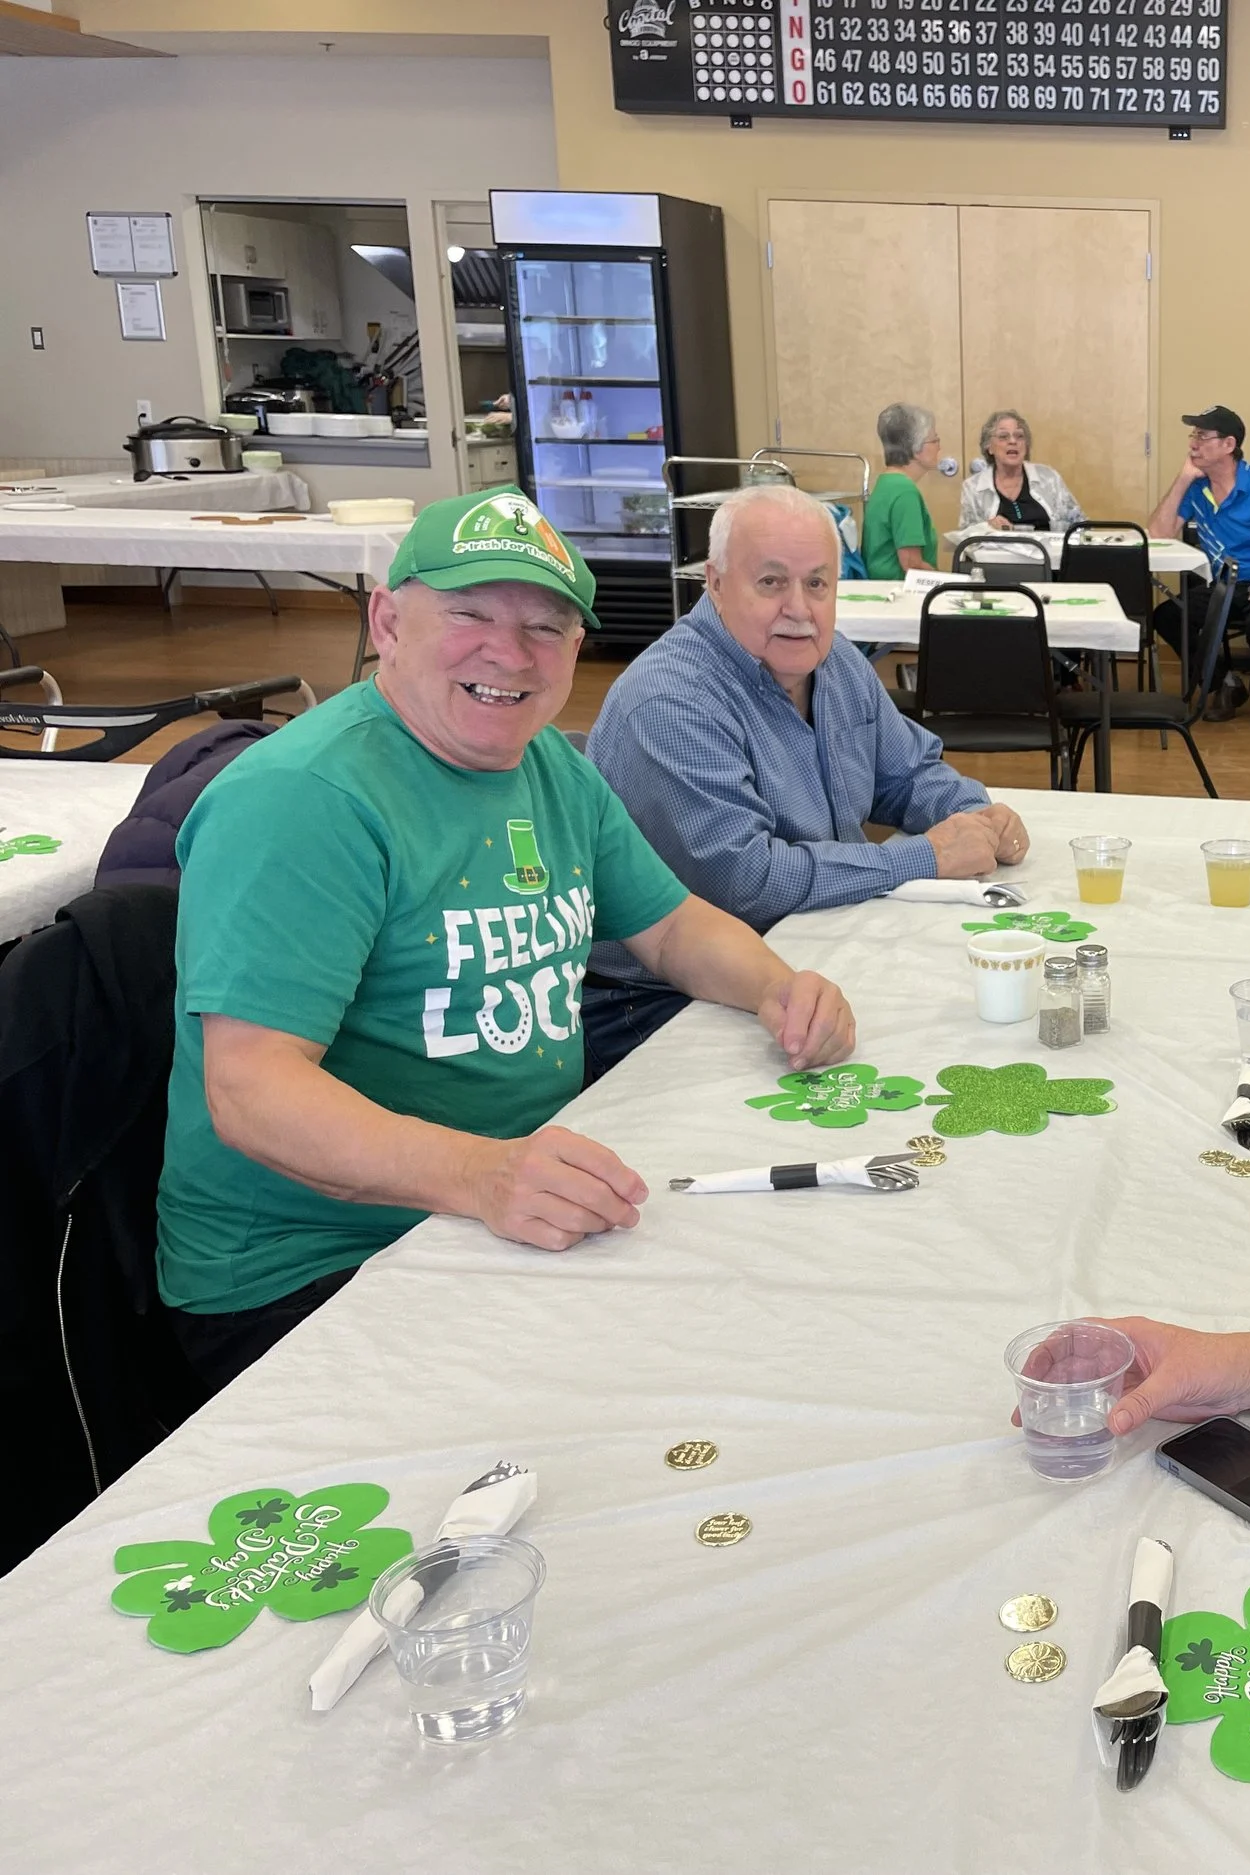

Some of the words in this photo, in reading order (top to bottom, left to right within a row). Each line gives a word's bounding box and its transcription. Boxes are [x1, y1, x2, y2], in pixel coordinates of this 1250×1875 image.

[814, 16, 834, 40] 31
[840, 17, 862, 41] 32
[867, 18, 890, 42] 33
[894, 18, 917, 42] 34
[921, 19, 944, 43] 35
[948, 19, 971, 44] 36
[975, 21, 997, 45] 37
[1005, 21, 1028, 45] 38
[1033, 21, 1056, 46] 39
[1061, 22, 1083, 47] 40
[1089, 23, 1110, 47] 41
[1115, 23, 1138, 48] 42
[1143, 24, 1166, 48] 43
[1170, 24, 1193, 49] 44
[1197, 25, 1221, 50] 45
[814, 48, 836, 72] 46
[841, 49, 863, 73] 47
[868, 50, 891, 74] 48
[895, 50, 917, 74] 49
[922, 51, 945, 75] 50
[951, 52, 970, 76] 51
[976, 52, 998, 76] 52
[1007, 53, 1029, 77] 53
[1033, 53, 1056, 78] 54
[1061, 54, 1084, 79] 55
[1088, 55, 1111, 80] 56
[1115, 56, 1138, 80] 57
[1142, 56, 1165, 81] 58
[1169, 57, 1192, 81] 59
[1197, 57, 1220, 82] 60
[816, 80, 837, 104] 61
[842, 81, 865, 105] 62
[869, 82, 892, 107] 63
[895, 83, 919, 107] 64
[923, 83, 946, 108] 65
[949, 84, 972, 108] 66
[977, 85, 1000, 109] 67
[1007, 85, 1030, 109] 68
[1034, 85, 1057, 110] 69
[1061, 86, 1084, 111] 70
[1089, 87, 1110, 111] 71
[1115, 87, 1138, 112] 72
[1142, 88, 1165, 113] 73
[1170, 89, 1192, 113] 74
[1197, 89, 1220, 114] 75
[201, 1528, 276, 1576] Day
[204, 1532, 321, 1611] Patrick's
[284, 1539, 360, 1586] Happy
[1203, 1646, 1248, 1704] Happy
